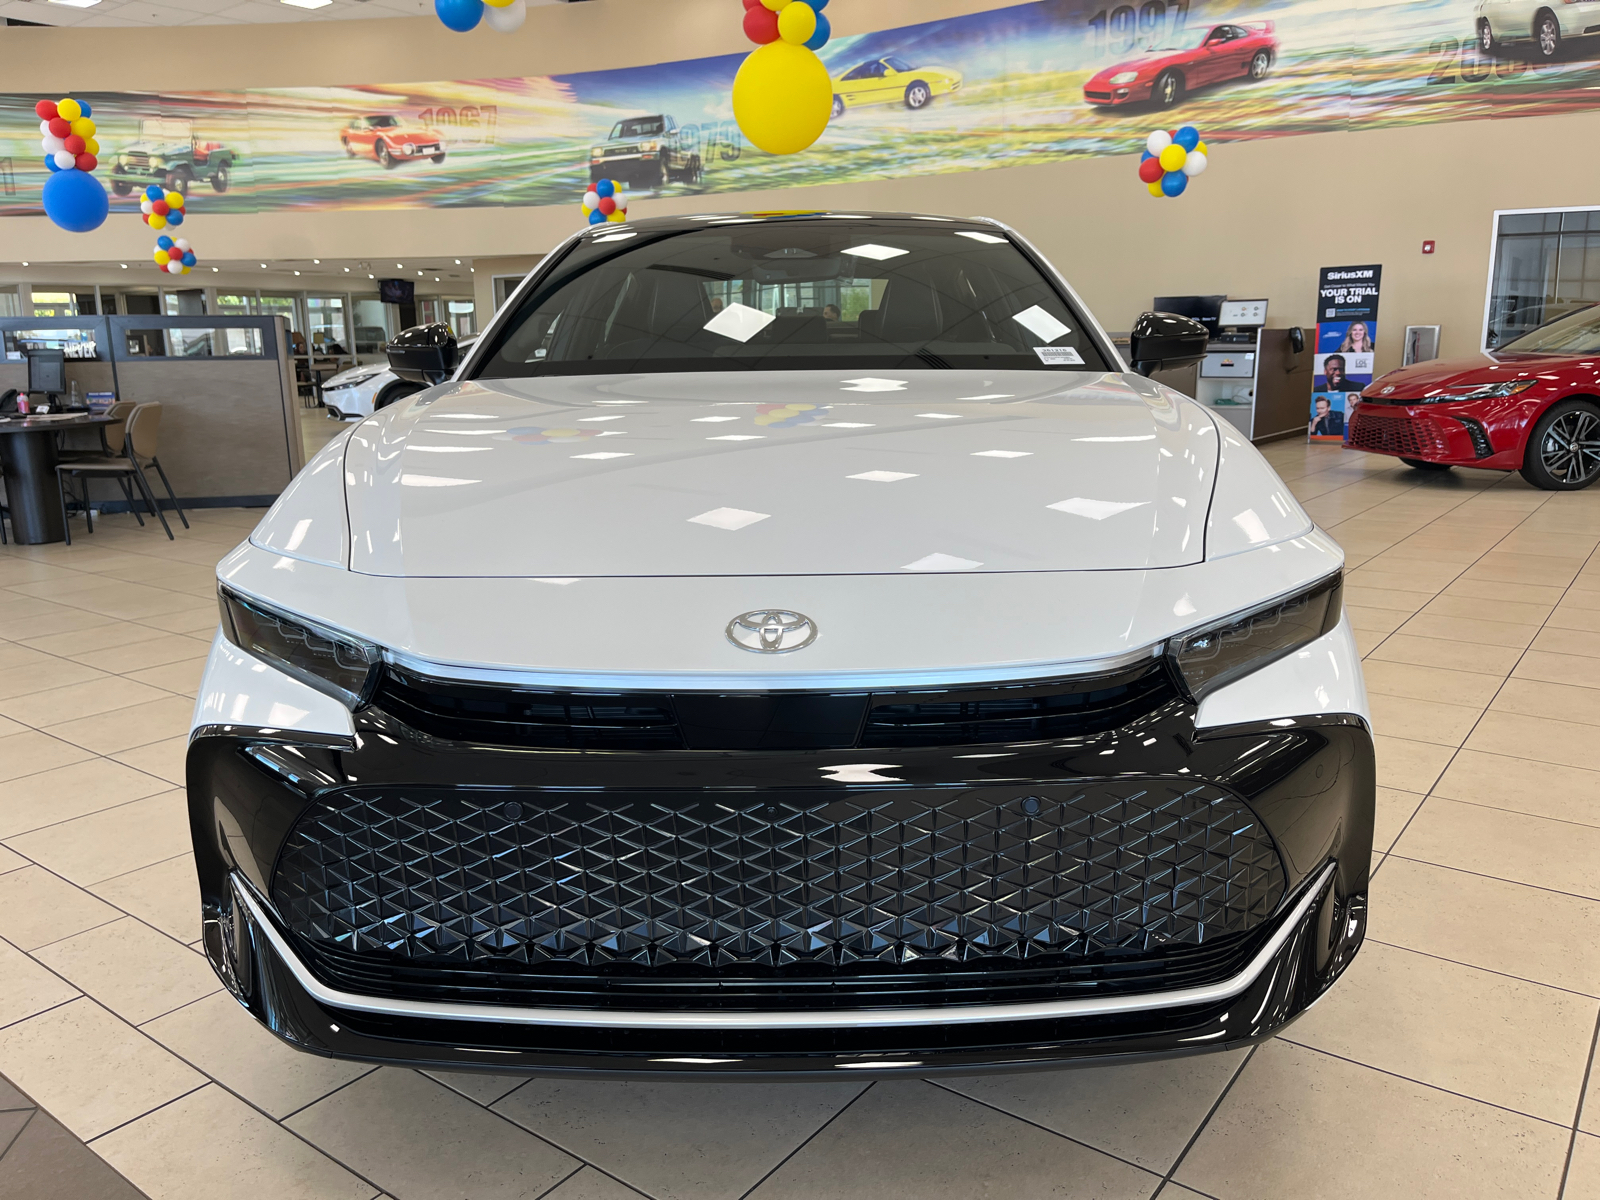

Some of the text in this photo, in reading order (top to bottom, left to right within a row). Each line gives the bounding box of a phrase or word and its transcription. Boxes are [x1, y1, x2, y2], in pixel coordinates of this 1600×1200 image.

[1088, 0, 1190, 59] 1997
[1327, 270, 1374, 280] SiriusXM
[1320, 287, 1378, 297] YOUR TRIAL
[1335, 295, 1362, 304] IS ON
[64, 341, 96, 358] NEVER
